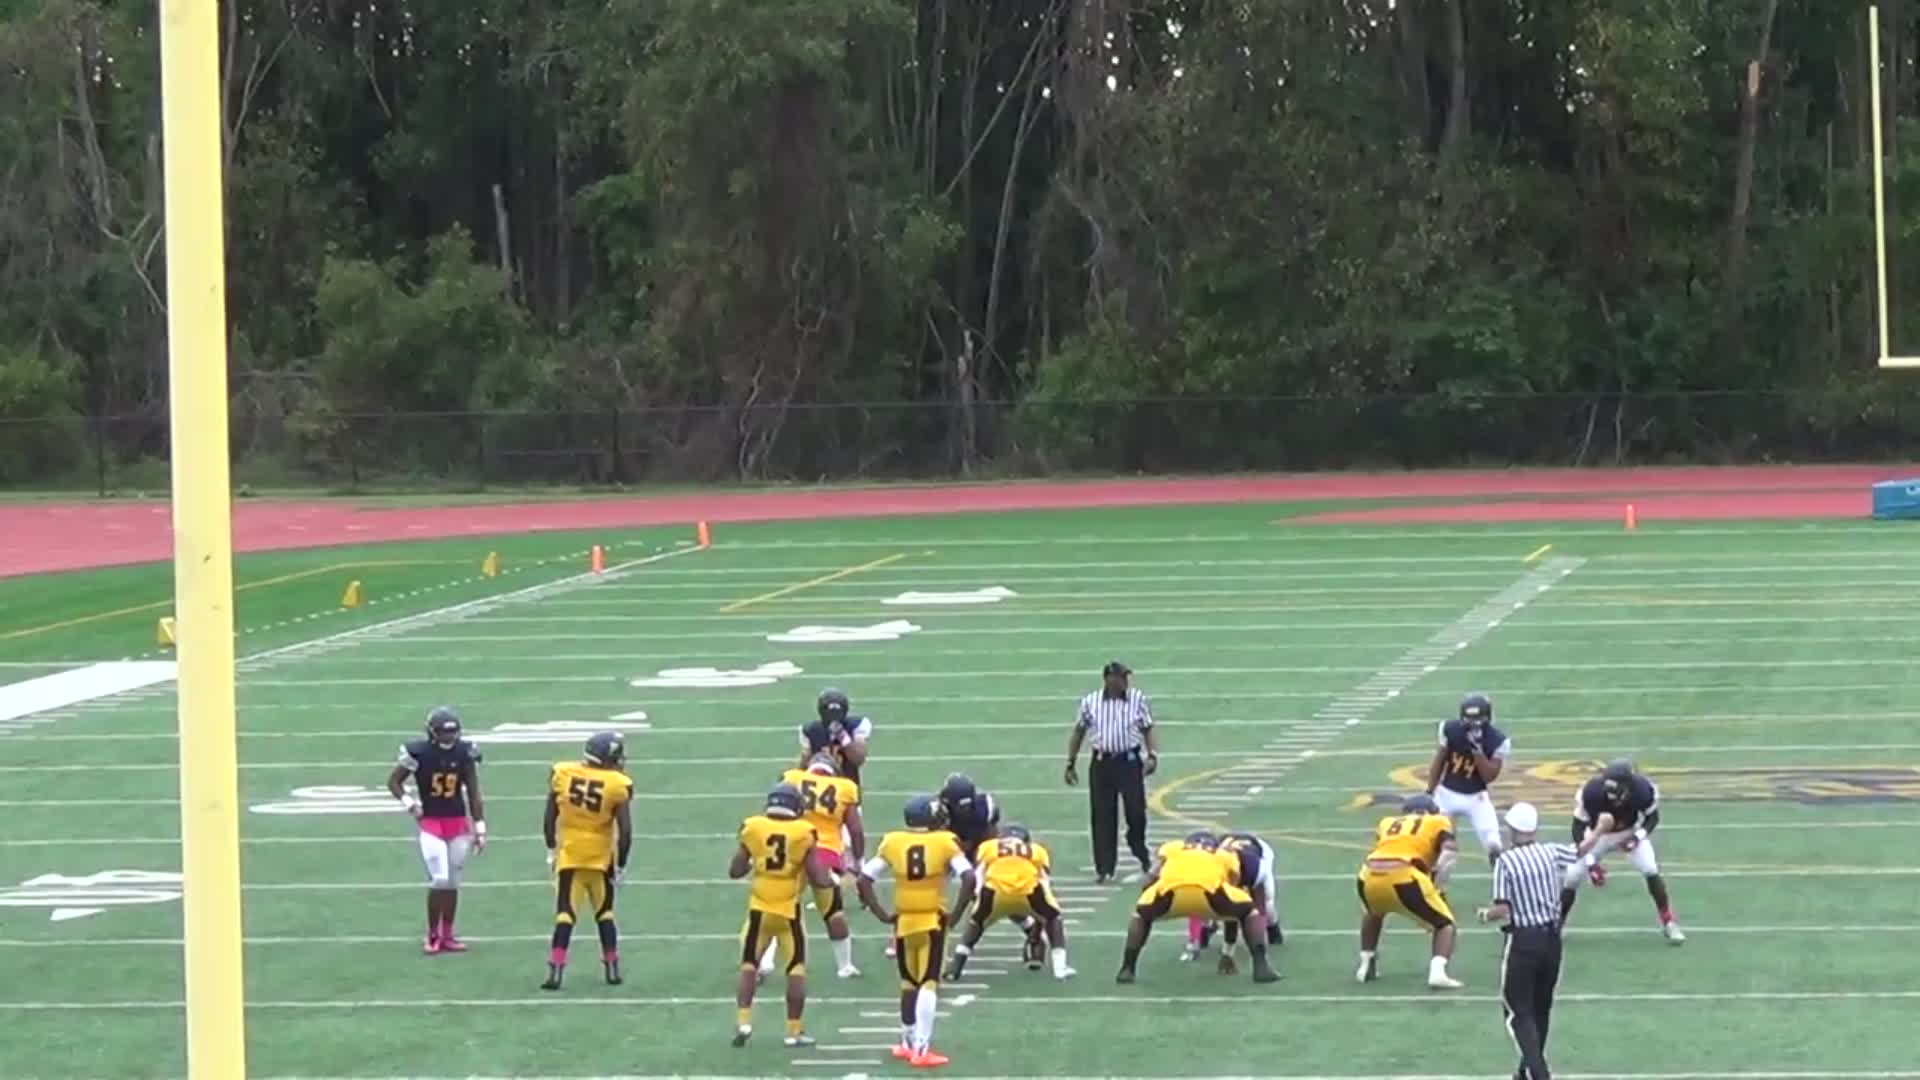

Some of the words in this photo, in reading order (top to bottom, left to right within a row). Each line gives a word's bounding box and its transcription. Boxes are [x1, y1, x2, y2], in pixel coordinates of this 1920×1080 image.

[1452, 752, 1475, 778] 44
[430, 773, 458, 797] 59
[568, 777, 604, 812] 55
[801, 780, 837, 813] 54
[765, 834, 787, 871] 3
[907, 845, 926, 881] 8
[998, 841, 1033, 858] 50
